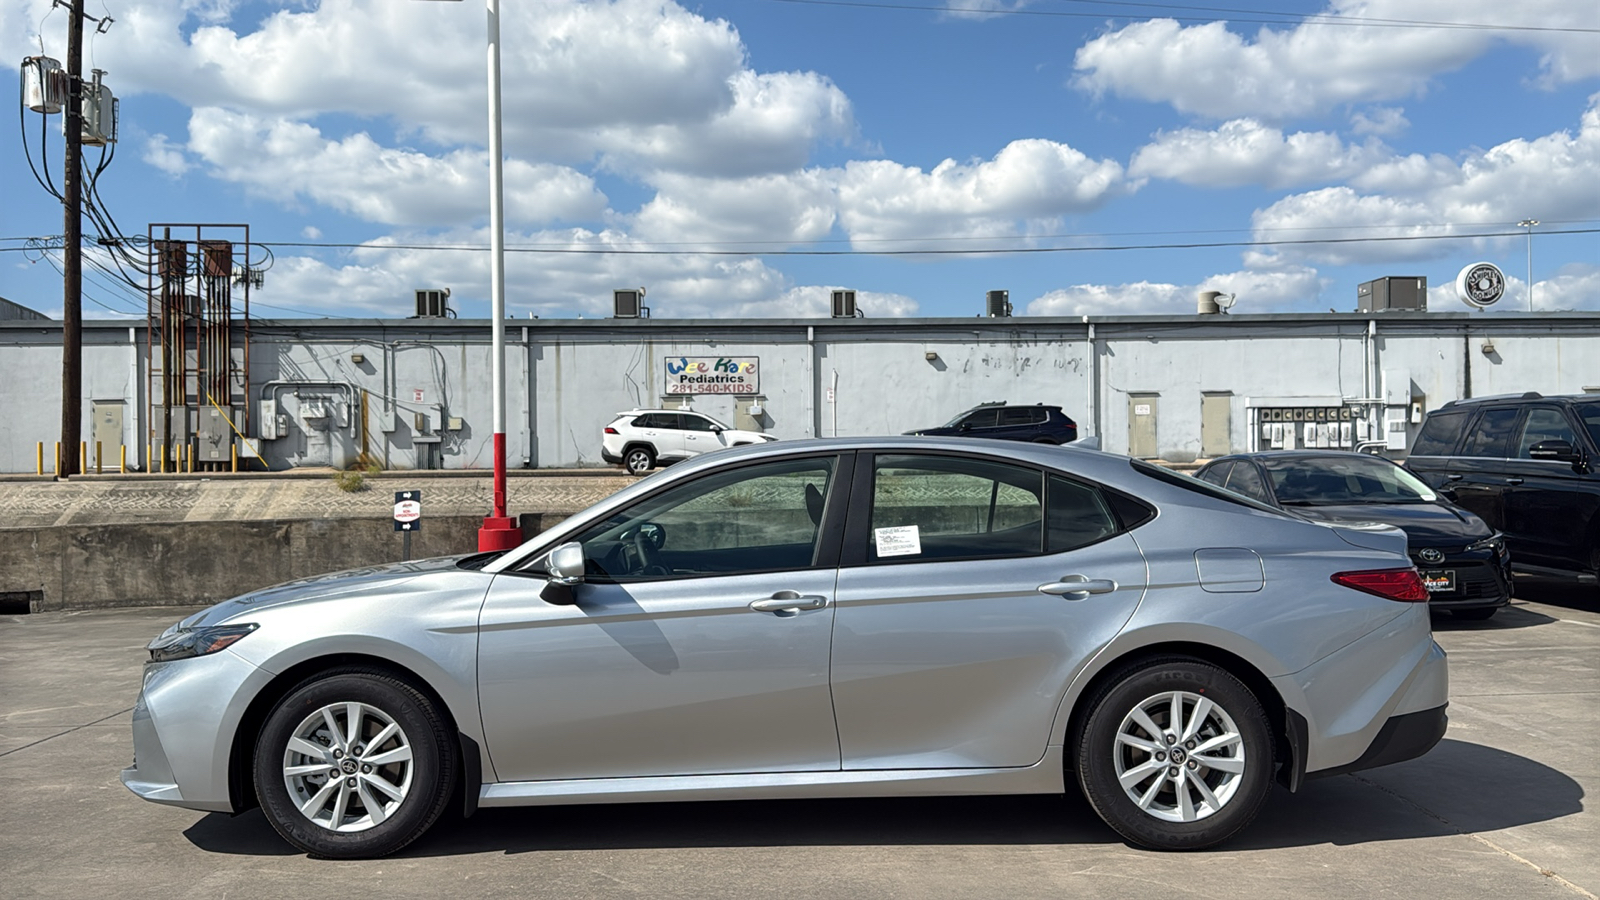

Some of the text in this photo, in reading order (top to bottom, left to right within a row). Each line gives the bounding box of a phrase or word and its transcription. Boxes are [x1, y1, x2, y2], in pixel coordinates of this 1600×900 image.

[668, 357, 756, 375] Wee Kare
[680, 374, 744, 383] Pediatrics
[672, 384, 753, 393] 281-540-KIDS
